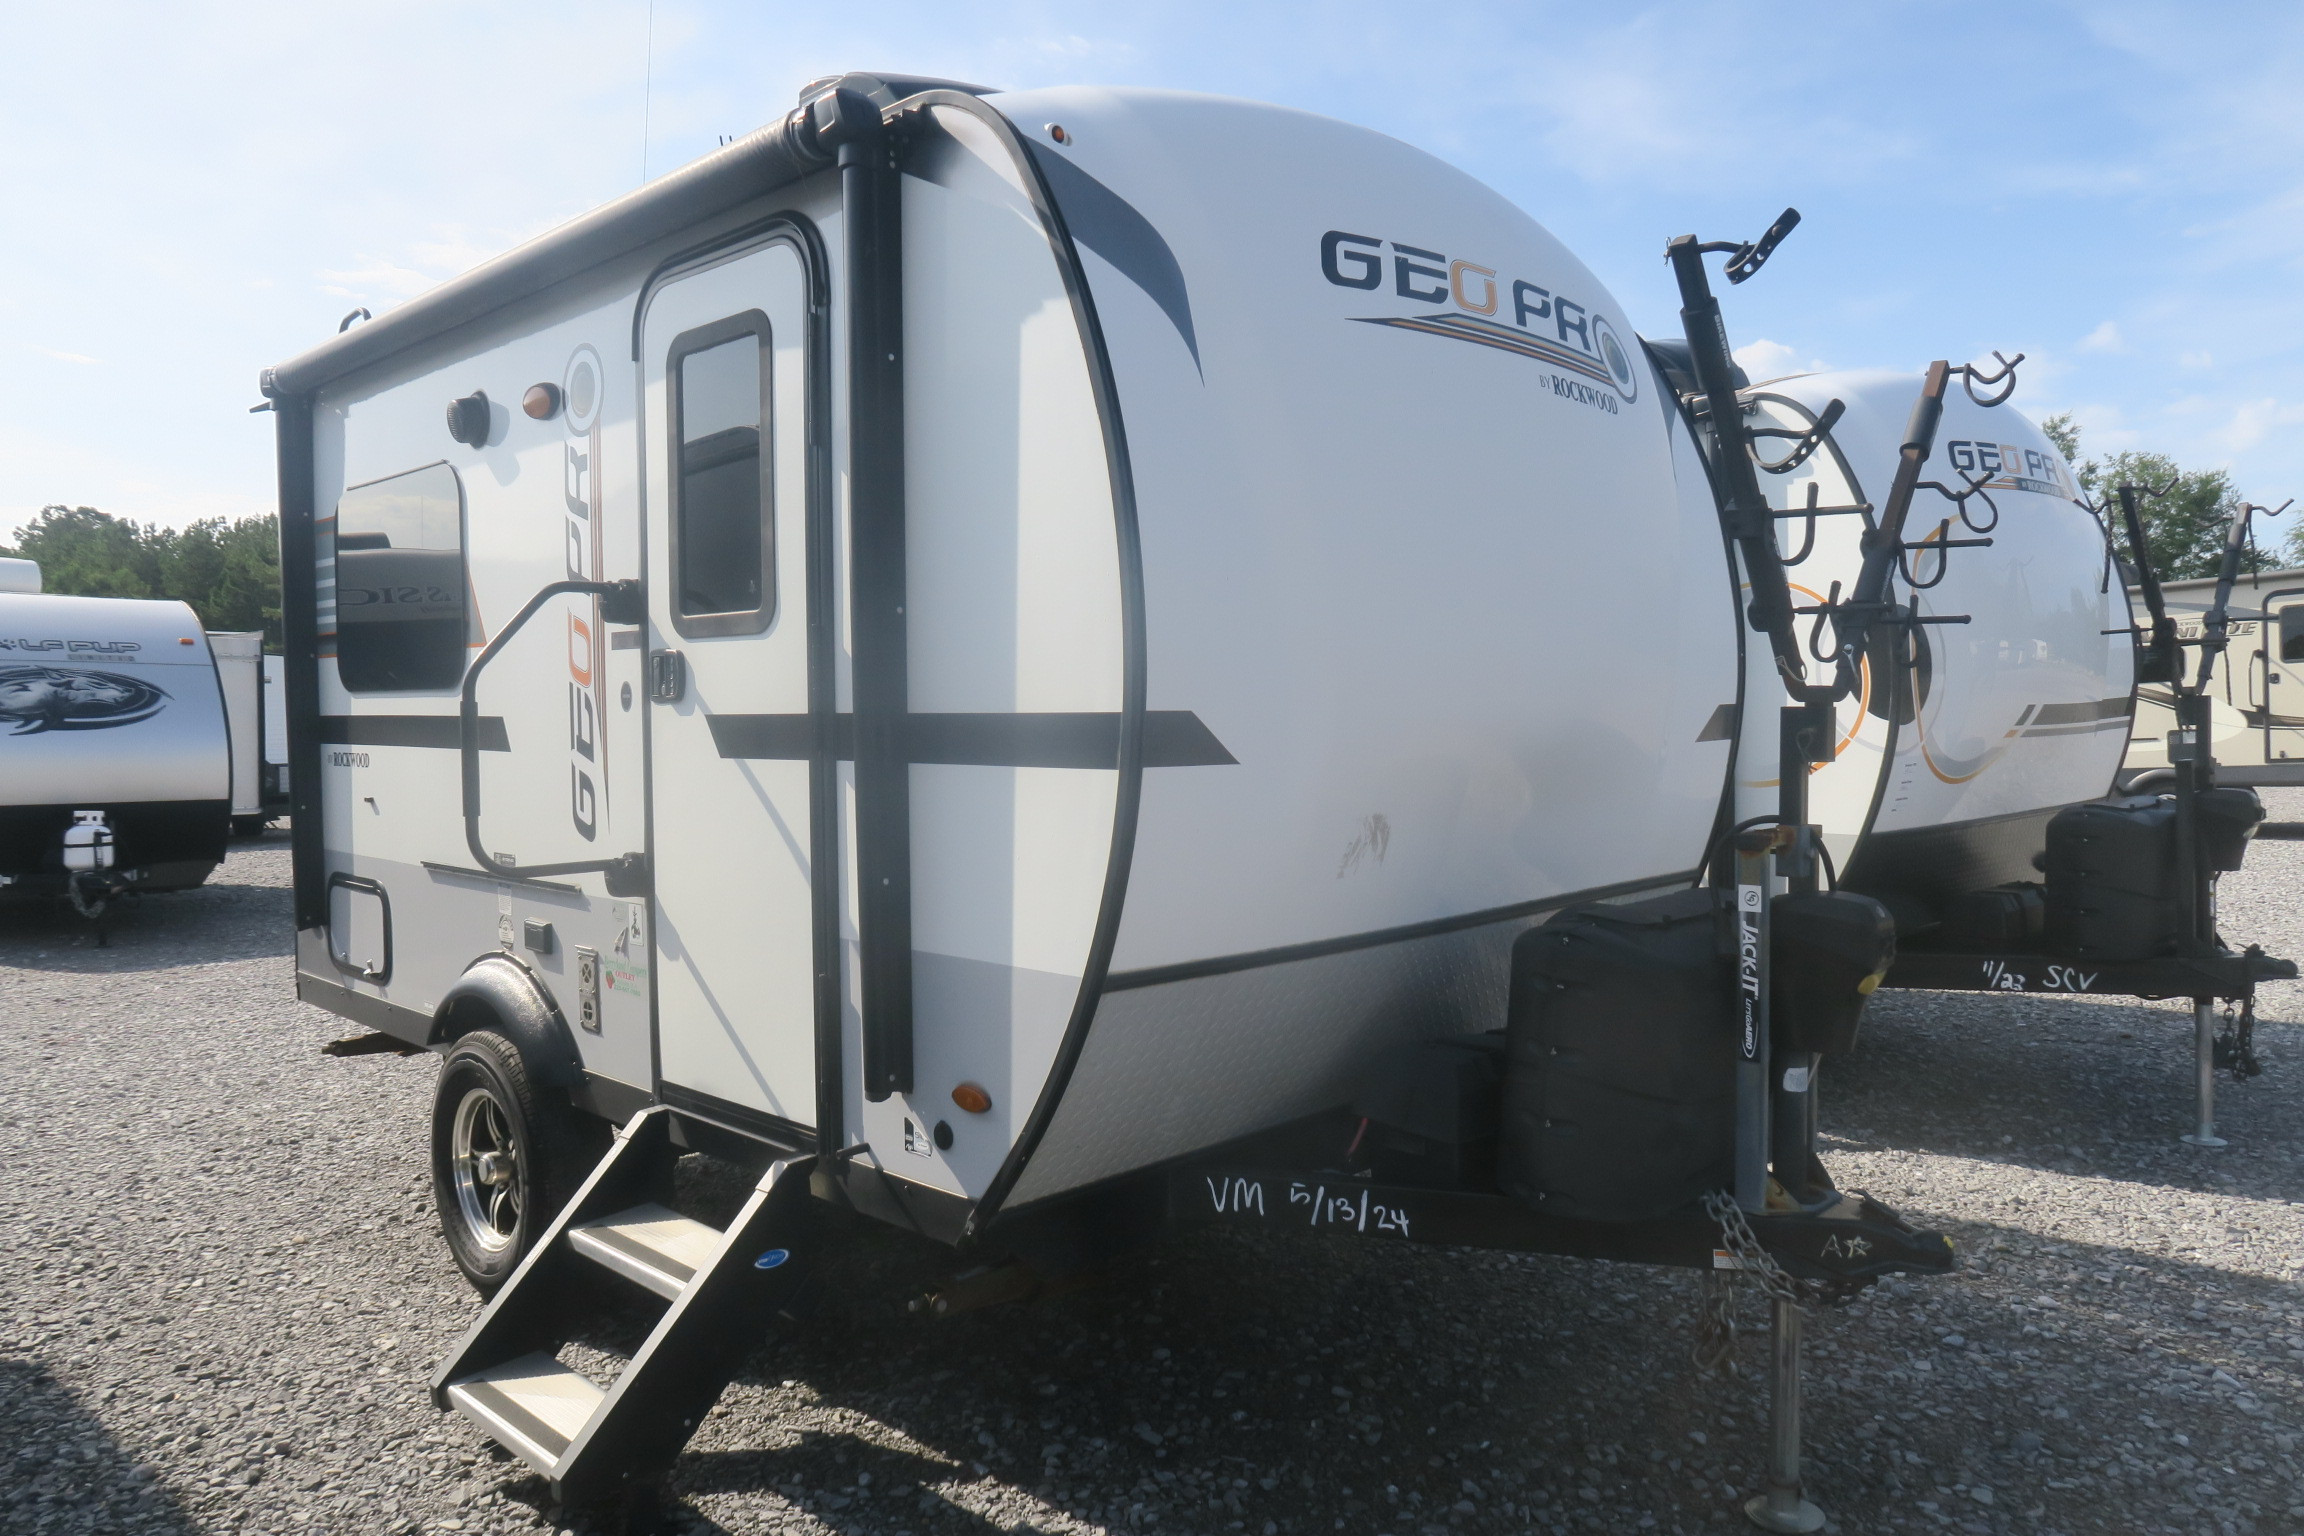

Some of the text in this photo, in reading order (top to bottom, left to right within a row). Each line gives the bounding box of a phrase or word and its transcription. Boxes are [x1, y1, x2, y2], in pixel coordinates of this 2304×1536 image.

[1320, 230, 1638, 404] GEO PRO
[1539, 374, 1619, 415] BY ROCKWOOD
[1947, 440, 2022, 474] GEO
[563, 343, 605, 843] GEO PRO
[67, 640, 142, 653] PUP
[333, 752, 370, 768] ROCKWOOD
[2042, 965, 2099, 992] SCV
[1206, 1176, 1410, 1238] VM 5/13/24
